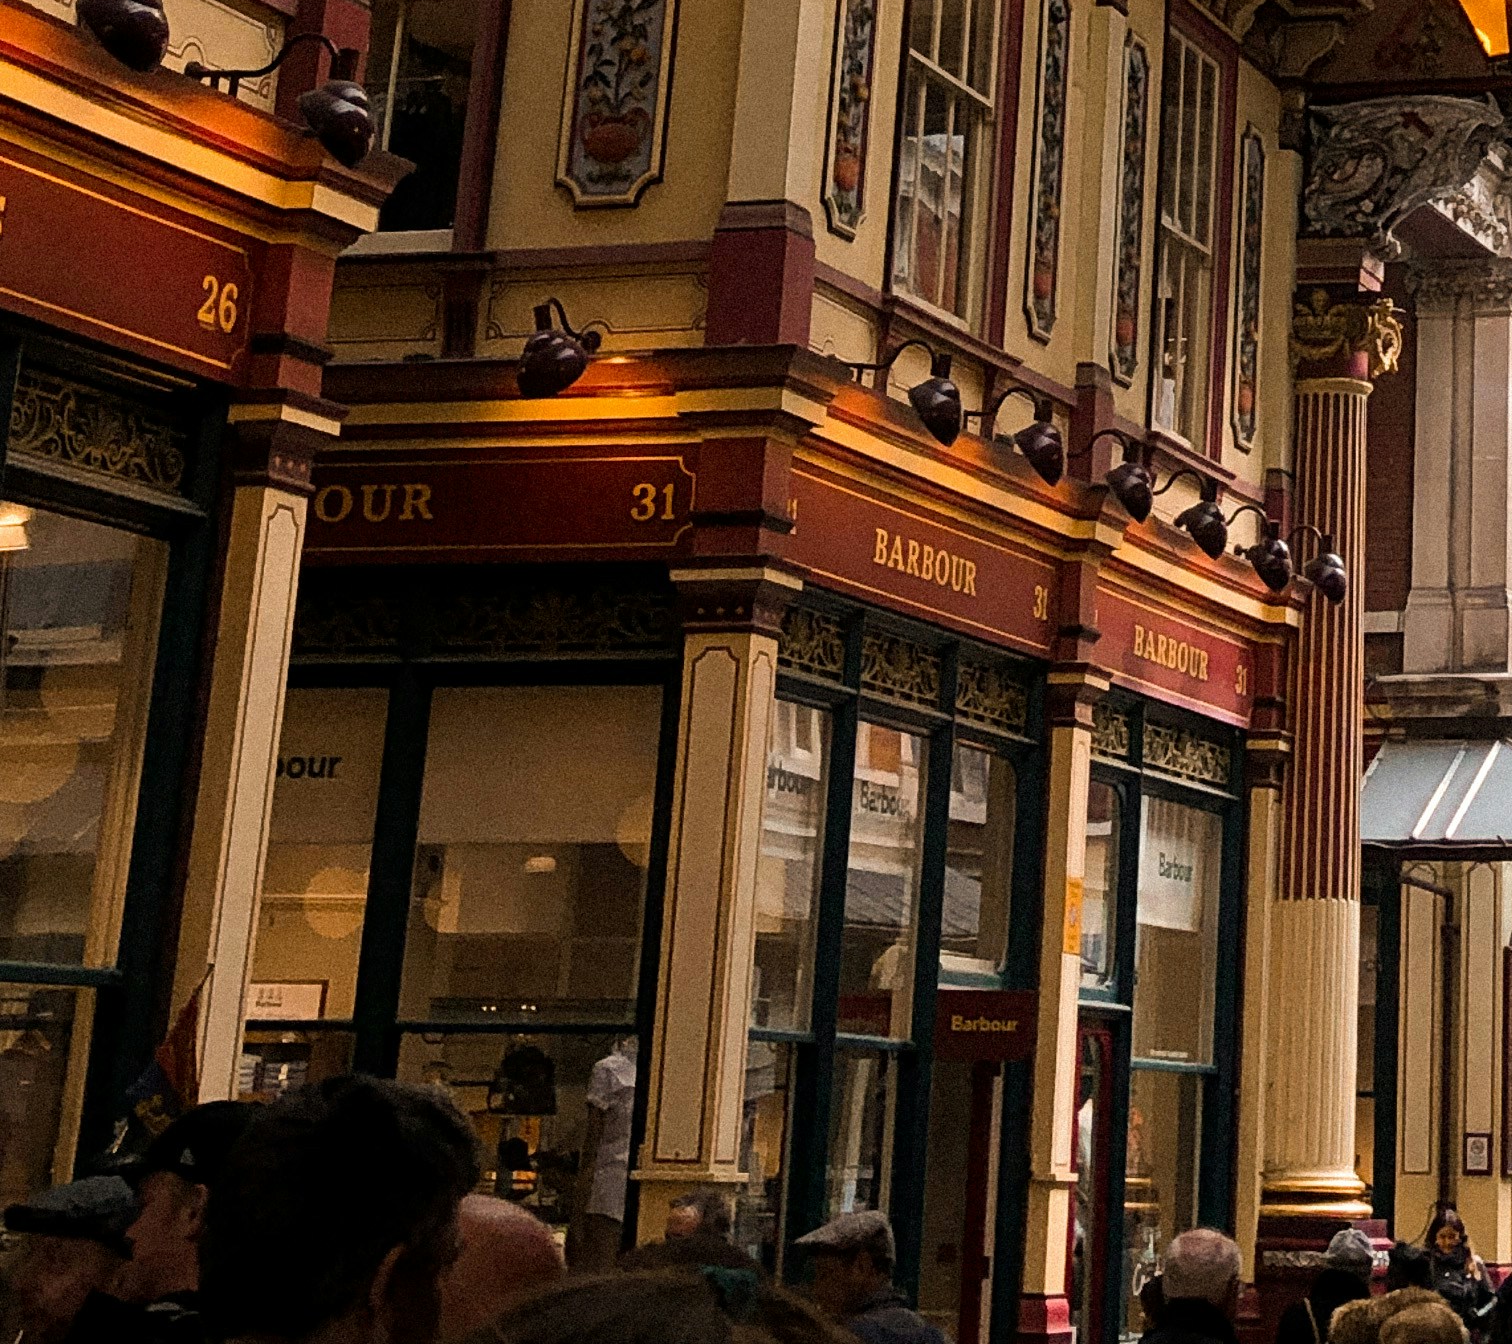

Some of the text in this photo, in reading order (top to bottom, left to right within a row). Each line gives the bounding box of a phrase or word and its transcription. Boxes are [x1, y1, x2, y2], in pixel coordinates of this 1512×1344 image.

[197, 275, 238, 333] 26
[631, 483, 675, 521] 31
[873, 527, 1048, 620] BARBOUR 31
[1133, 624, 1248, 696] BARBOUR 31
[951, 1014, 1018, 1031] Barbour
